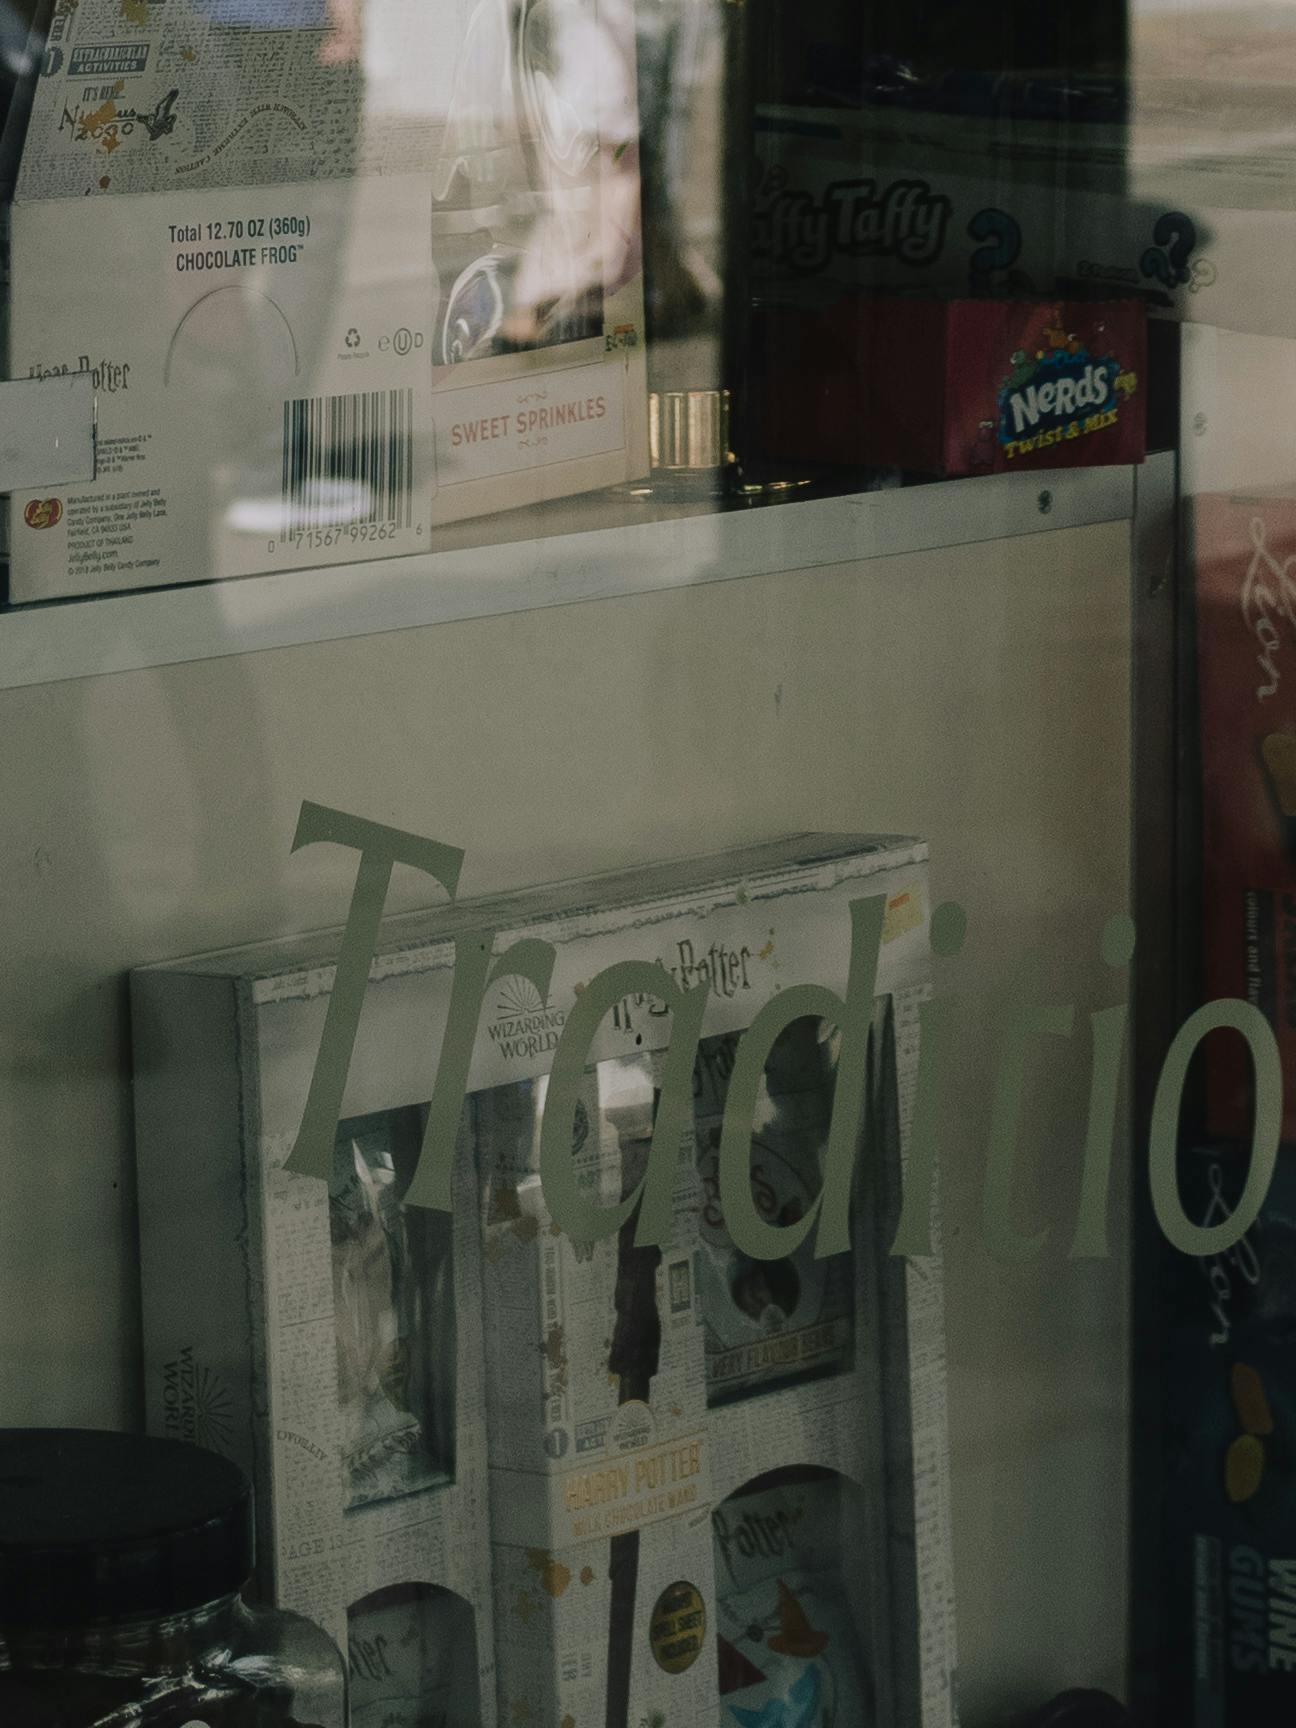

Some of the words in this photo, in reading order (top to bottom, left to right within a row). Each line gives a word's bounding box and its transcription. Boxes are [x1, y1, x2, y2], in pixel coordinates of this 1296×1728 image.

[76, 60, 138, 73] ACTIVITIES
[168, 223, 202, 243] Total
[206, 220, 244, 241] 12.70
[247, 219, 266, 238] OZ
[268, 215, 312, 241] (360g)
[830, 179, 952, 268] Taffy
[175, 248, 257, 272] CHOCOLATE
[450, 415, 511, 446] SWEET
[516, 395, 607, 435] SPRINKLES
[1004, 428, 1063, 459] Twist
[294, 528, 342, 551] 71567
[349, 521, 397, 542] 99262
[499, 1032, 560, 1060] WORLD
[634, 1441, 702, 1495] POTTER
